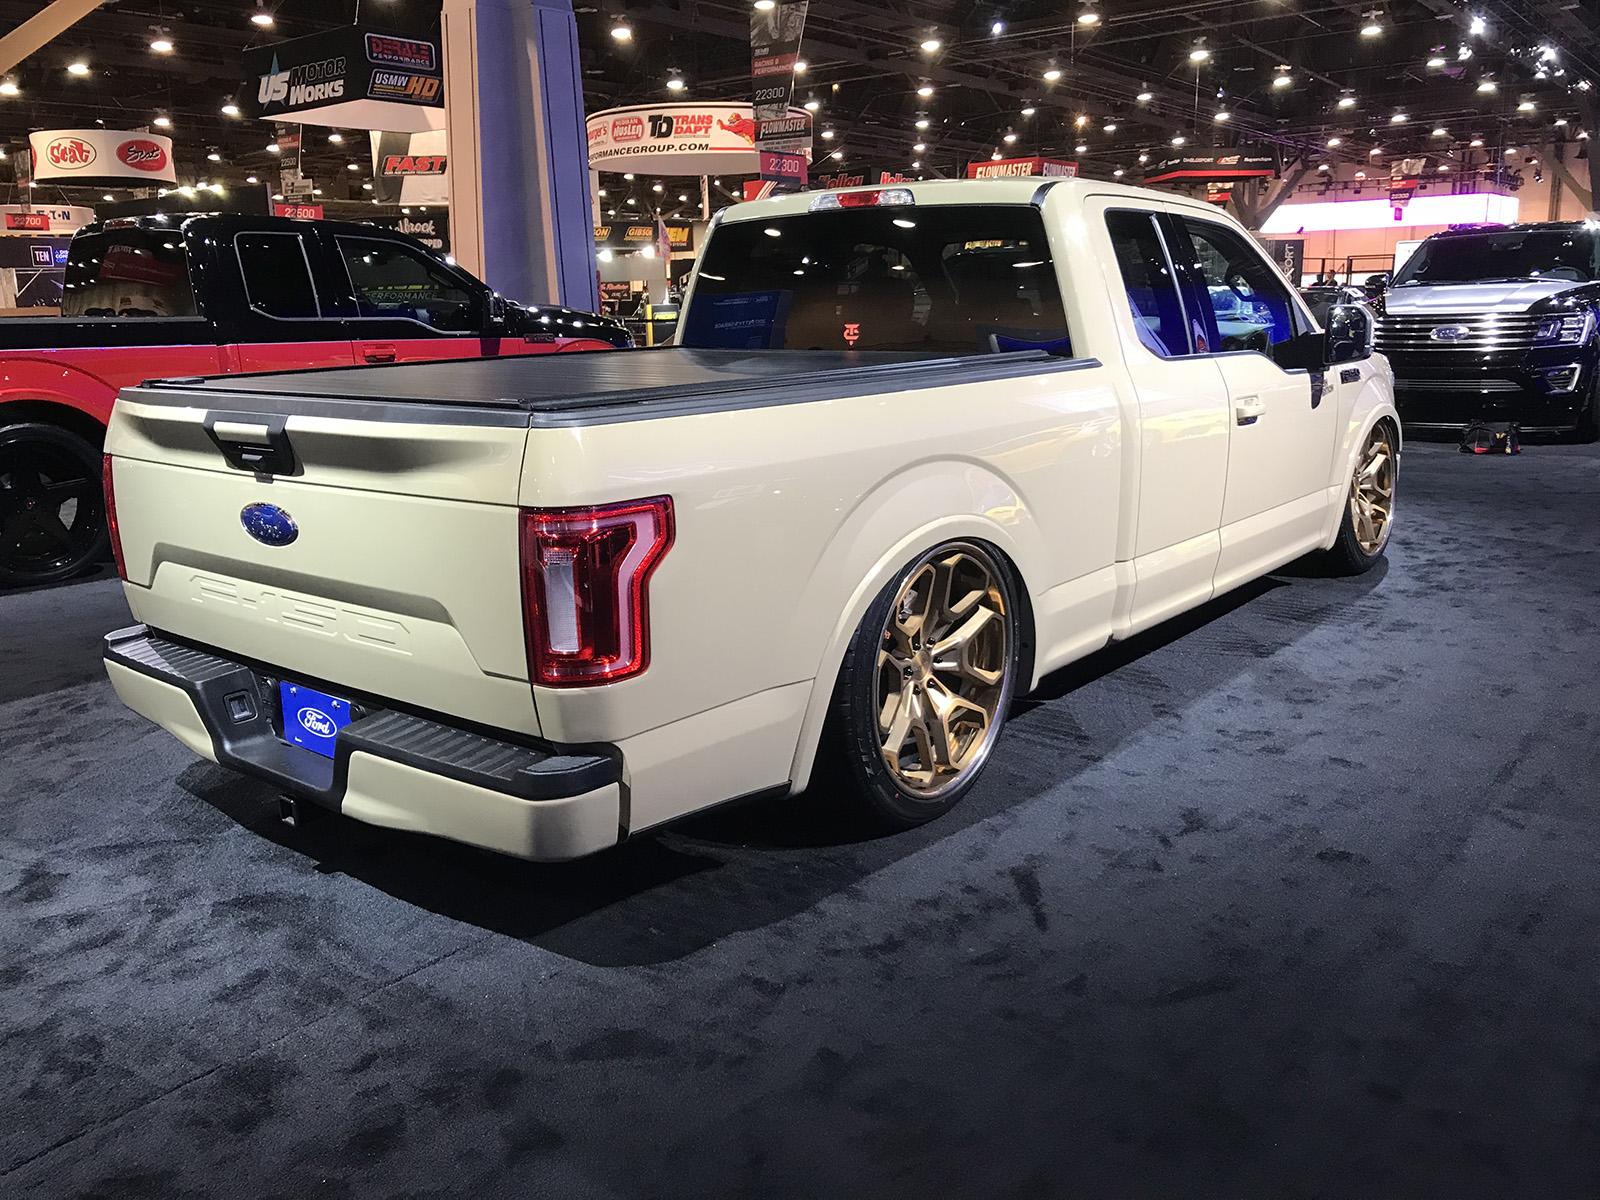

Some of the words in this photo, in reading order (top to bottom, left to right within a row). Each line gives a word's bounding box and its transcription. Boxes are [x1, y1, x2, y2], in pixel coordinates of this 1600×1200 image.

[290, 56, 346, 86] MOTOR
[258, 70, 291, 103] US
[289, 80, 345, 105] WORKS
[375, 73, 408, 87] USMW
[405, 76, 440, 97] HD
[755, 87, 785, 100] 22300
[648, 114, 674, 139] TD
[673, 114, 713, 125] TRANS
[674, 125, 712, 135] DAPT
[760, 119, 806, 139] FLOWMASTER
[50, 140, 90, 164] Scat
[385, 156, 446, 171] FAST
[769, 158, 800, 173] 22300
[975, 162, 1033, 179] FLOWMASTER
[284, 207, 315, 218] 22500
[14, 217, 42, 226] 22700
[34, 250, 50, 262] TEN
[304, 710, 330, 735] Ford
